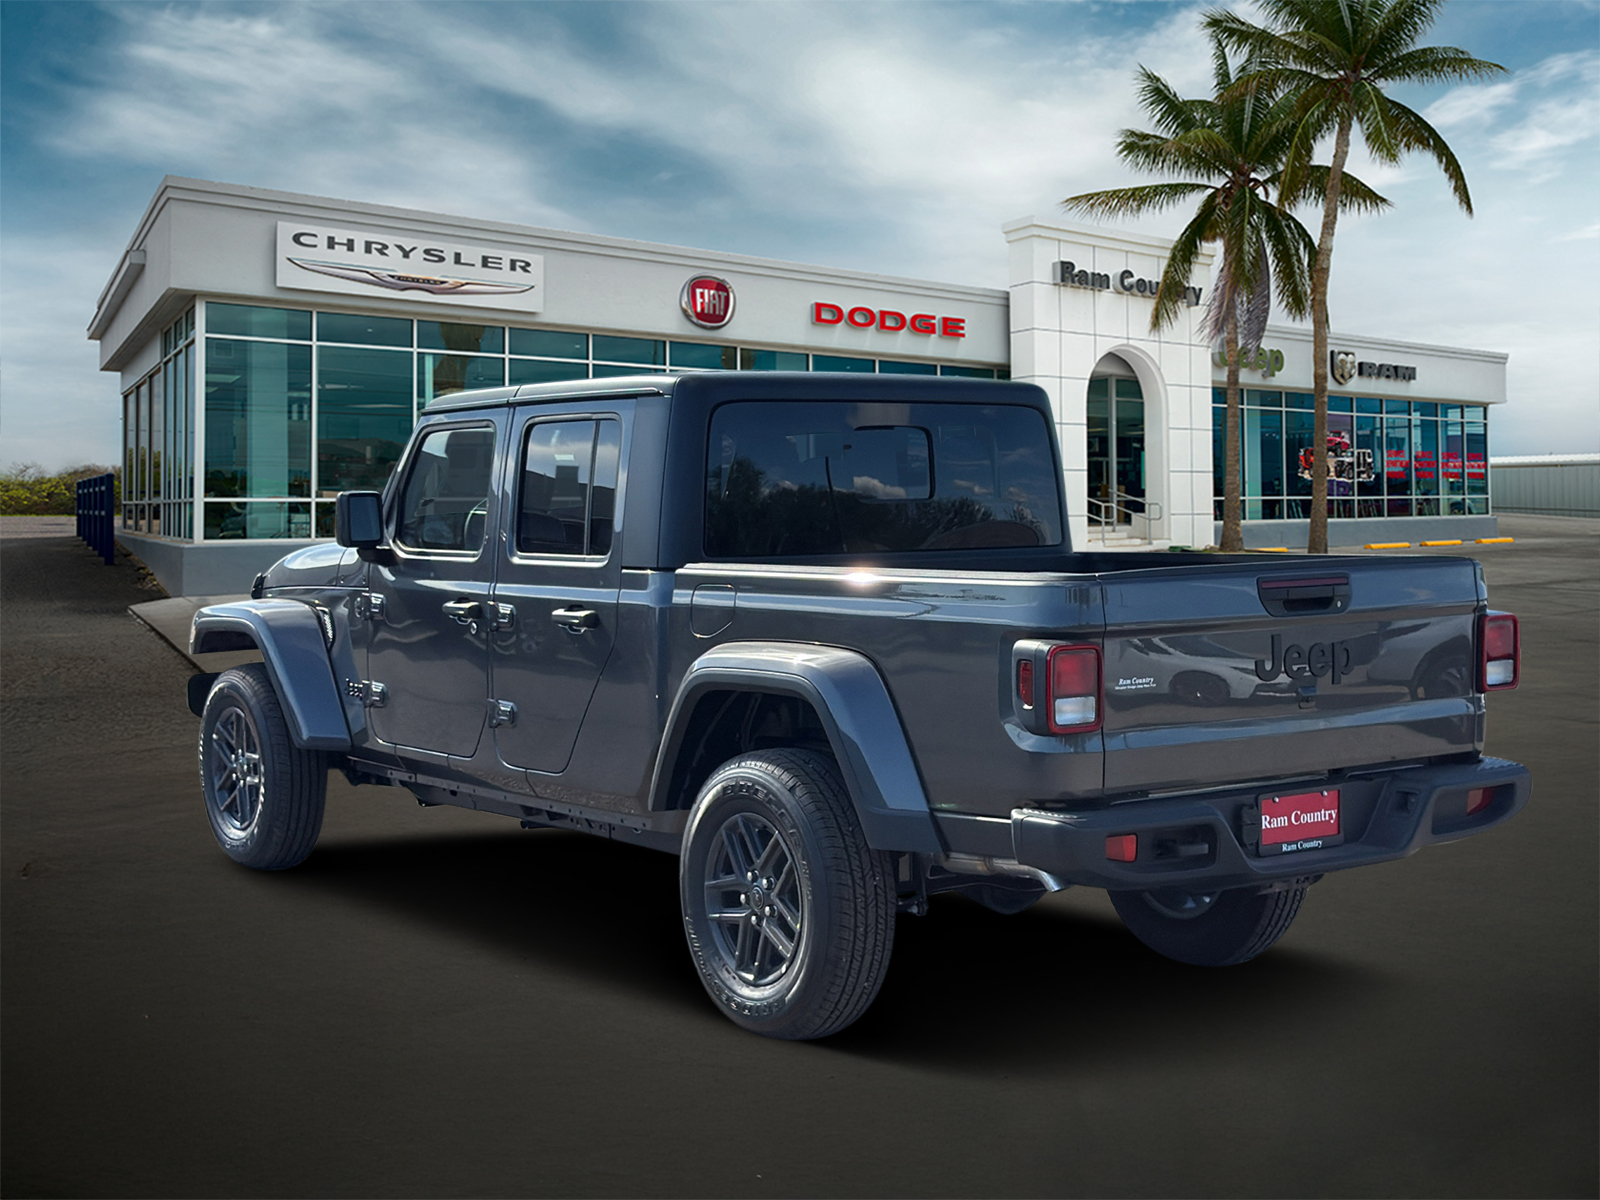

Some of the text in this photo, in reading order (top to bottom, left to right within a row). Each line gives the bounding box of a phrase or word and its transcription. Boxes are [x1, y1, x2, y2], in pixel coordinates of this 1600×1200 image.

[292, 232, 531, 273] CHRYSLER
[1058, 261, 1203, 306] Ram Coury
[695, 287, 728, 316] FIAT
[813, 302, 966, 338] DODGE
[1219, 346, 1284, 377] eep
[1359, 362, 1416, 381] RAM
[1254, 633, 1350, 685] Jeep
[1261, 809, 1337, 829] Ram Country
[1282, 840, 1323, 852] Ram Country
